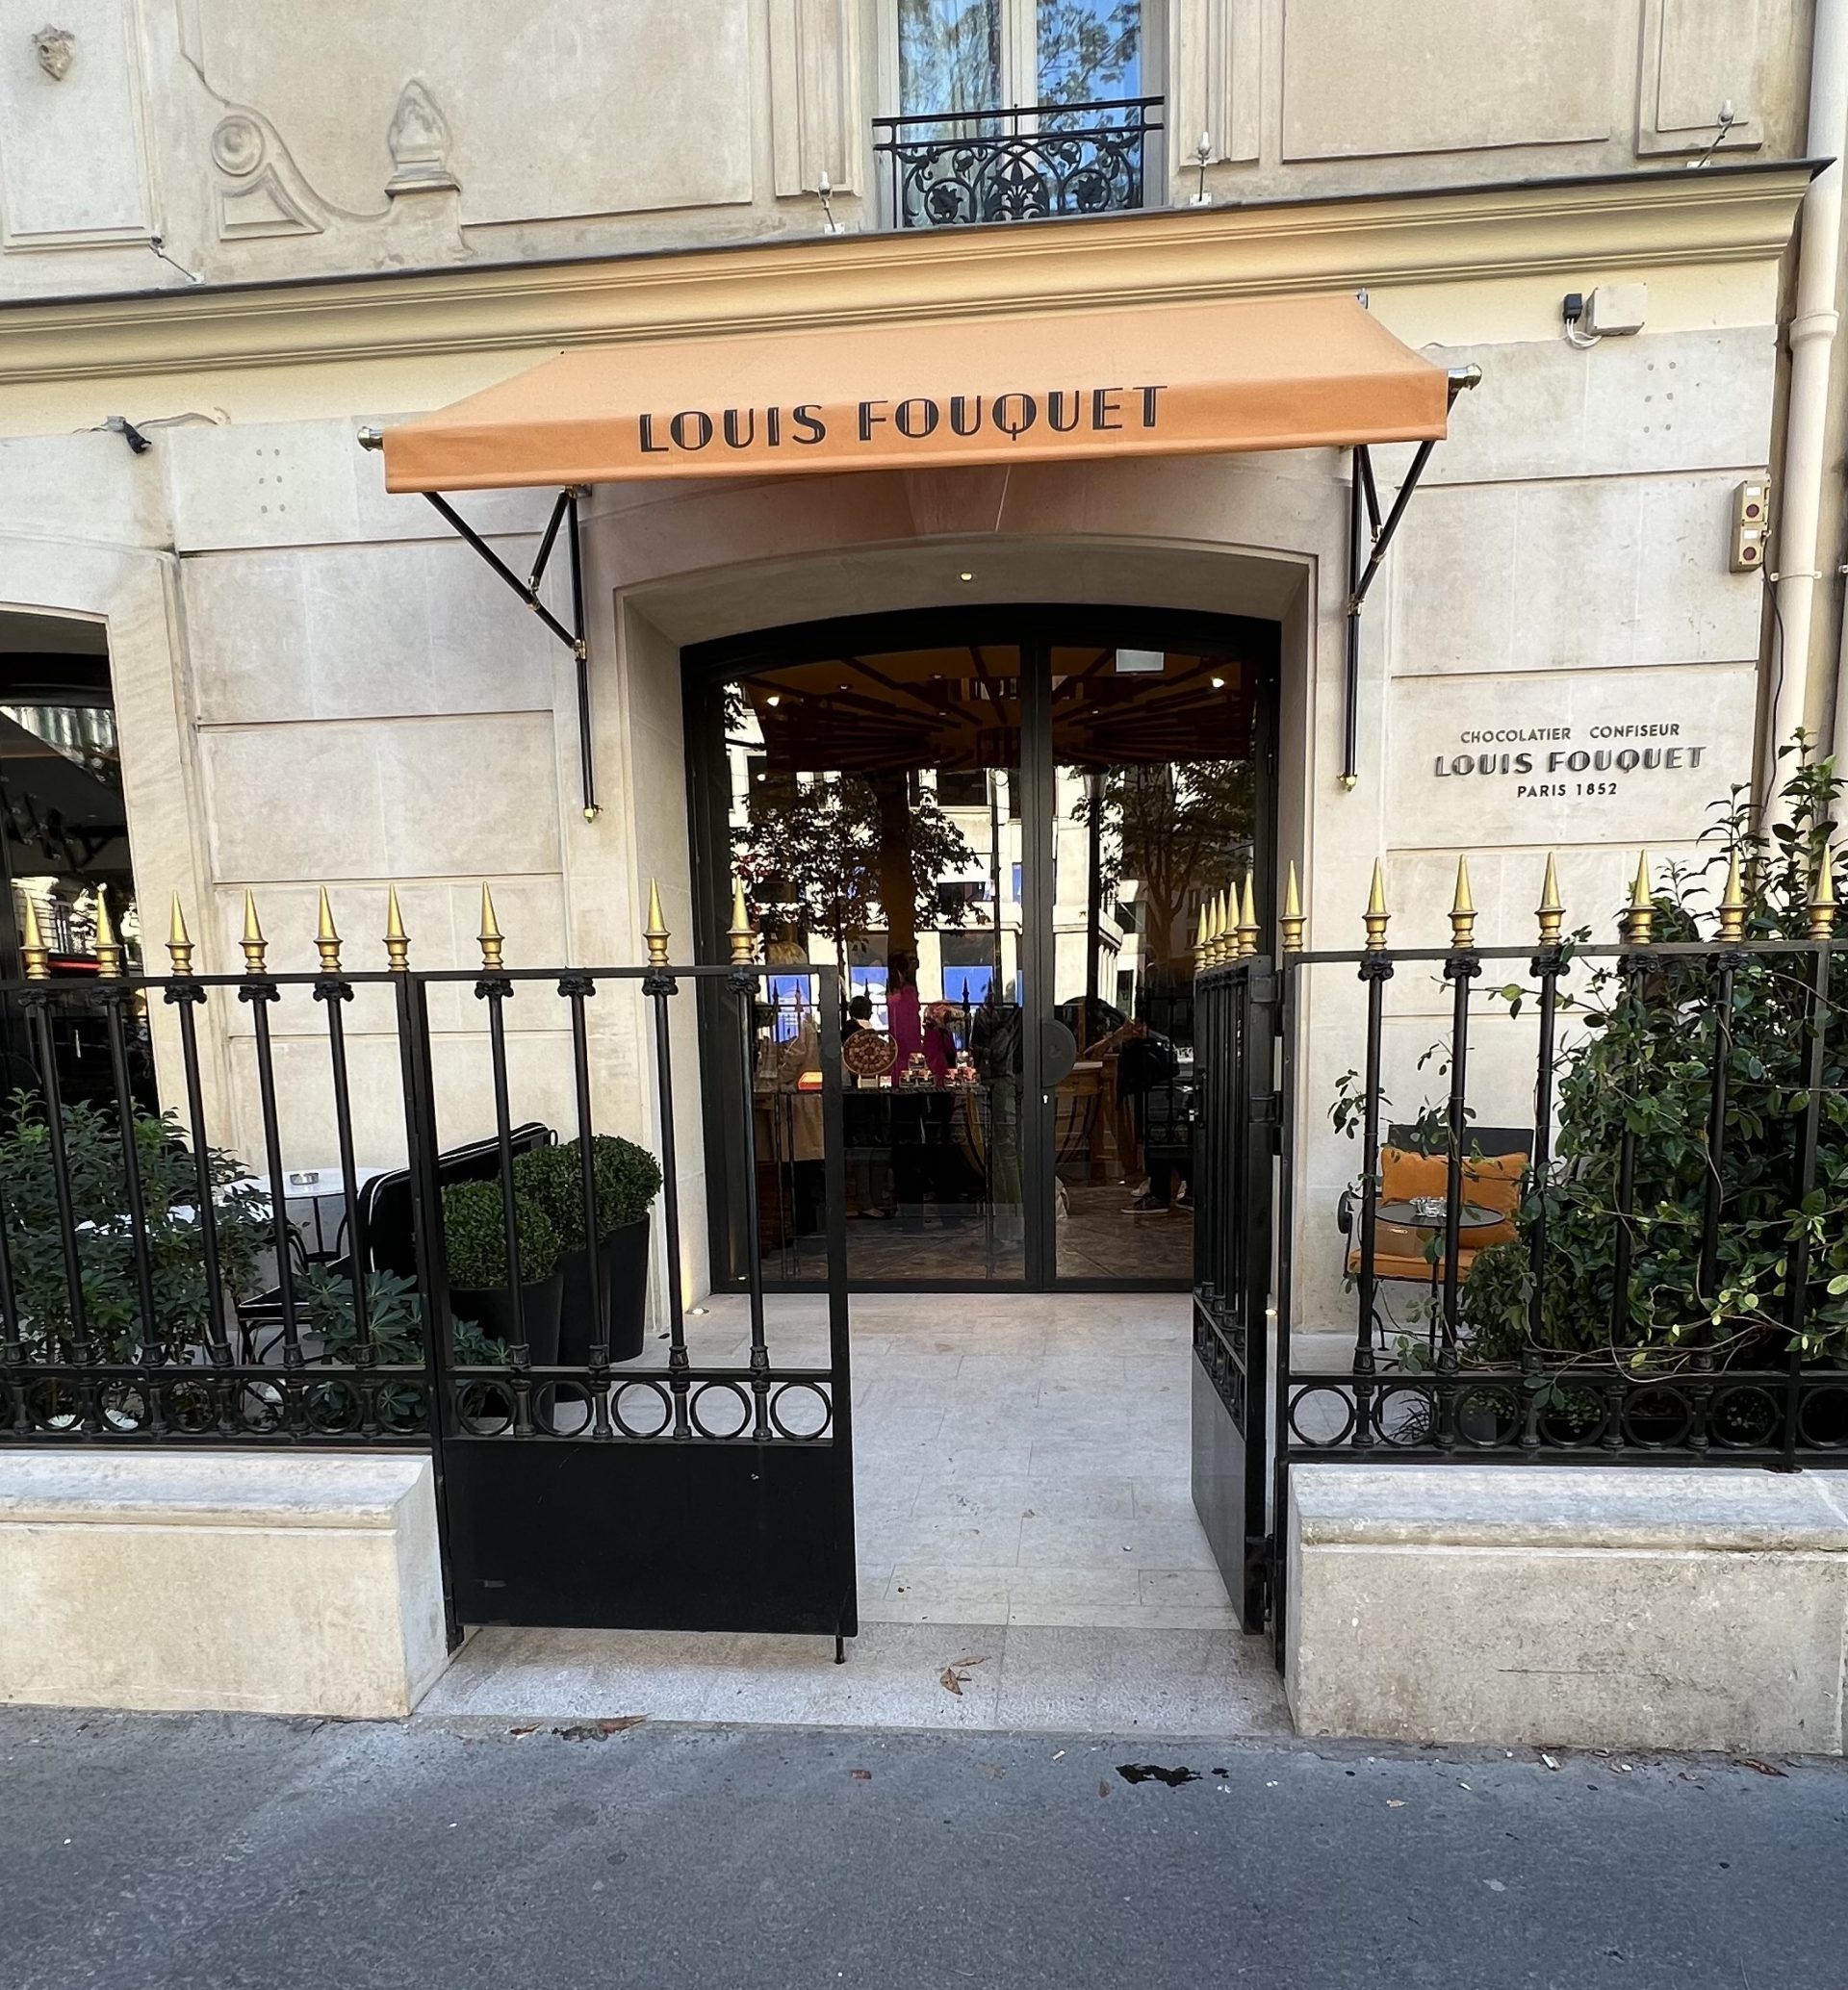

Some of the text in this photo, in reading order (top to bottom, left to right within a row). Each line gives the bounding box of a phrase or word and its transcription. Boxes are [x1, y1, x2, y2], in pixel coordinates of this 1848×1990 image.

[639, 386, 1168, 452] LOUIS FOUQUET
[1460, 724, 1681, 743] CHOCOLATIER CONFISEUR
[1435, 747, 1707, 777] LOUIS FOUQUET
[1517, 783, 1618, 798] PARIS 1852
